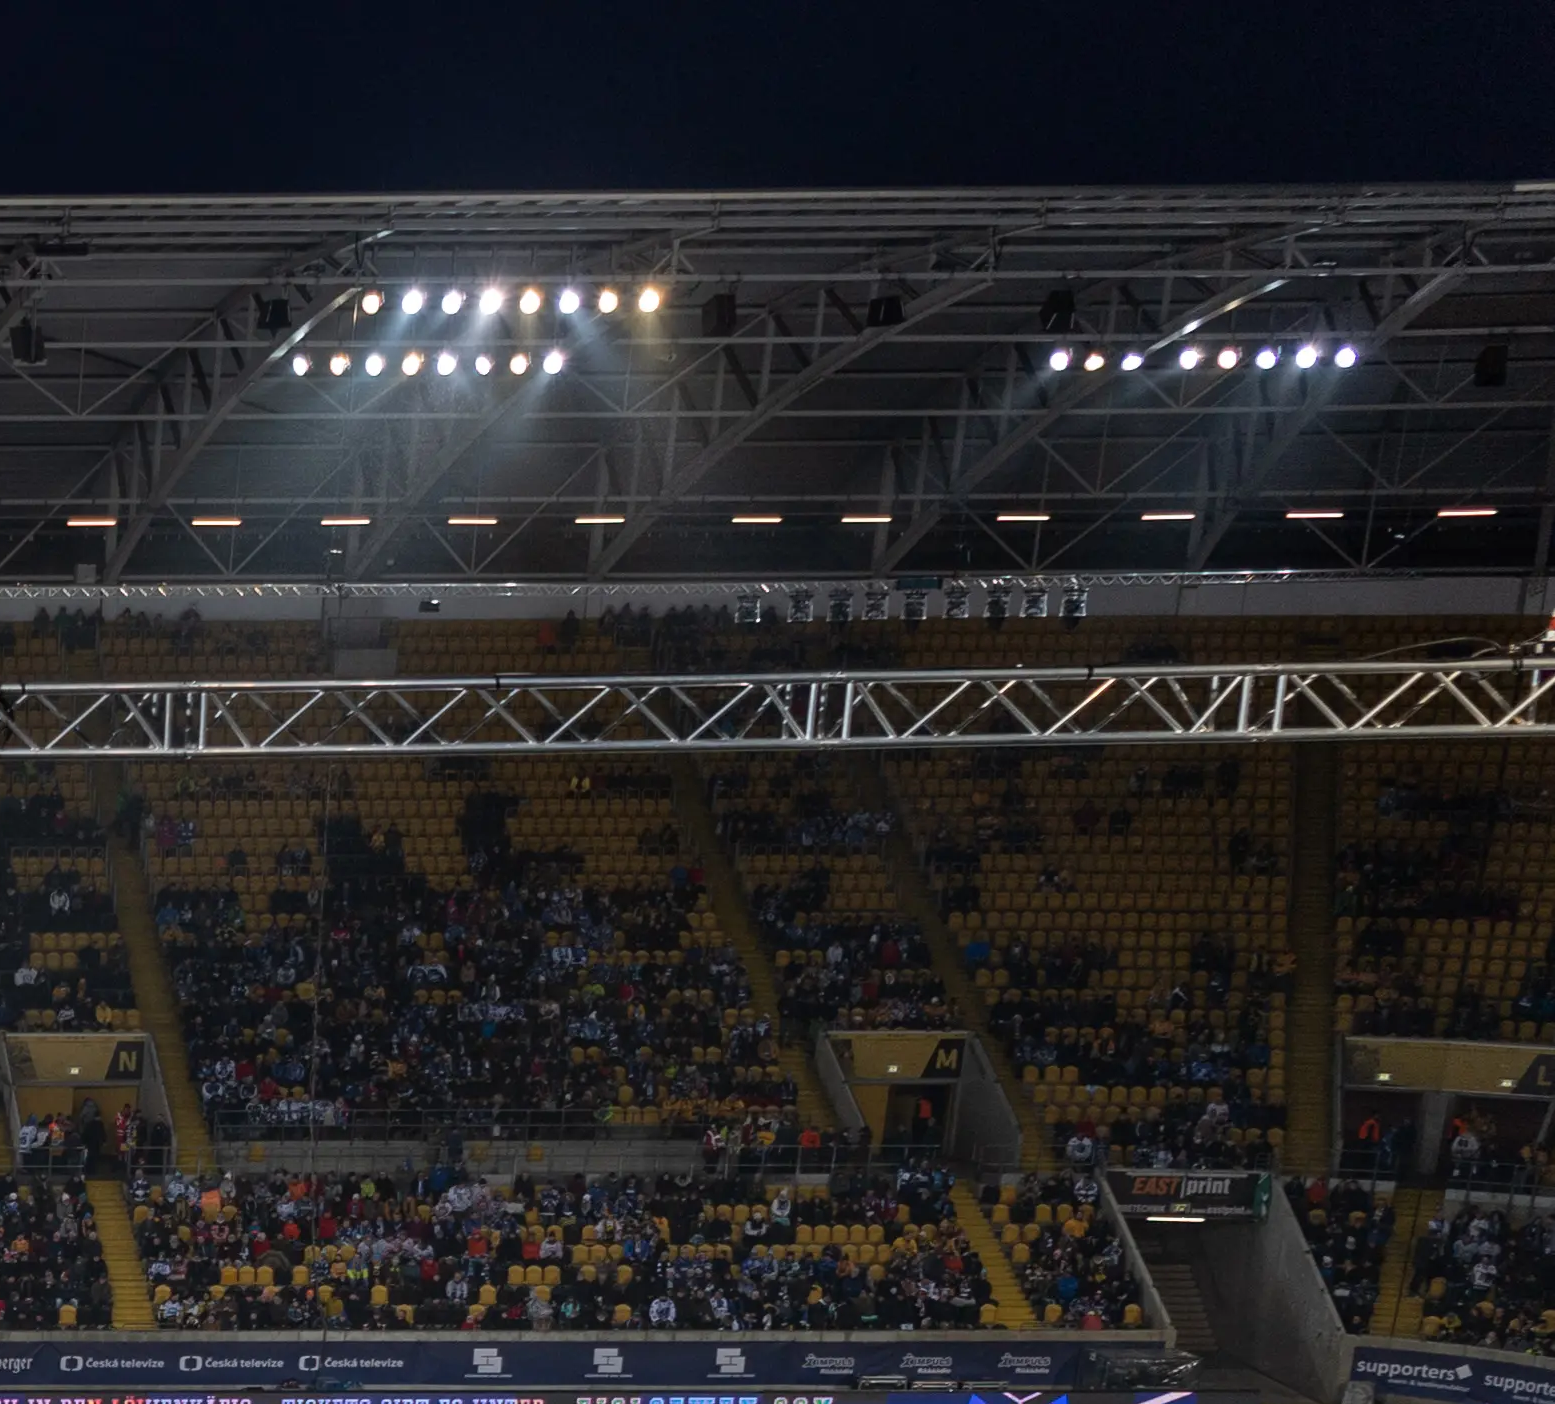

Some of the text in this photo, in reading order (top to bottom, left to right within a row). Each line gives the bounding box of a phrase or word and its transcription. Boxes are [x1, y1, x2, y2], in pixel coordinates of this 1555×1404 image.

[119, 1051, 136, 1072] N
[936, 1049, 957, 1069] M
[1537, 1066, 1551, 1086] L
[1132, 1177, 1231, 1195] EAST print
[85, 1356, 164, 1369] Česká televize
[205, 1356, 284, 1369] Česká televize
[324, 1357, 404, 1370] Česká televize
[1356, 1359, 1455, 1381] supporters
